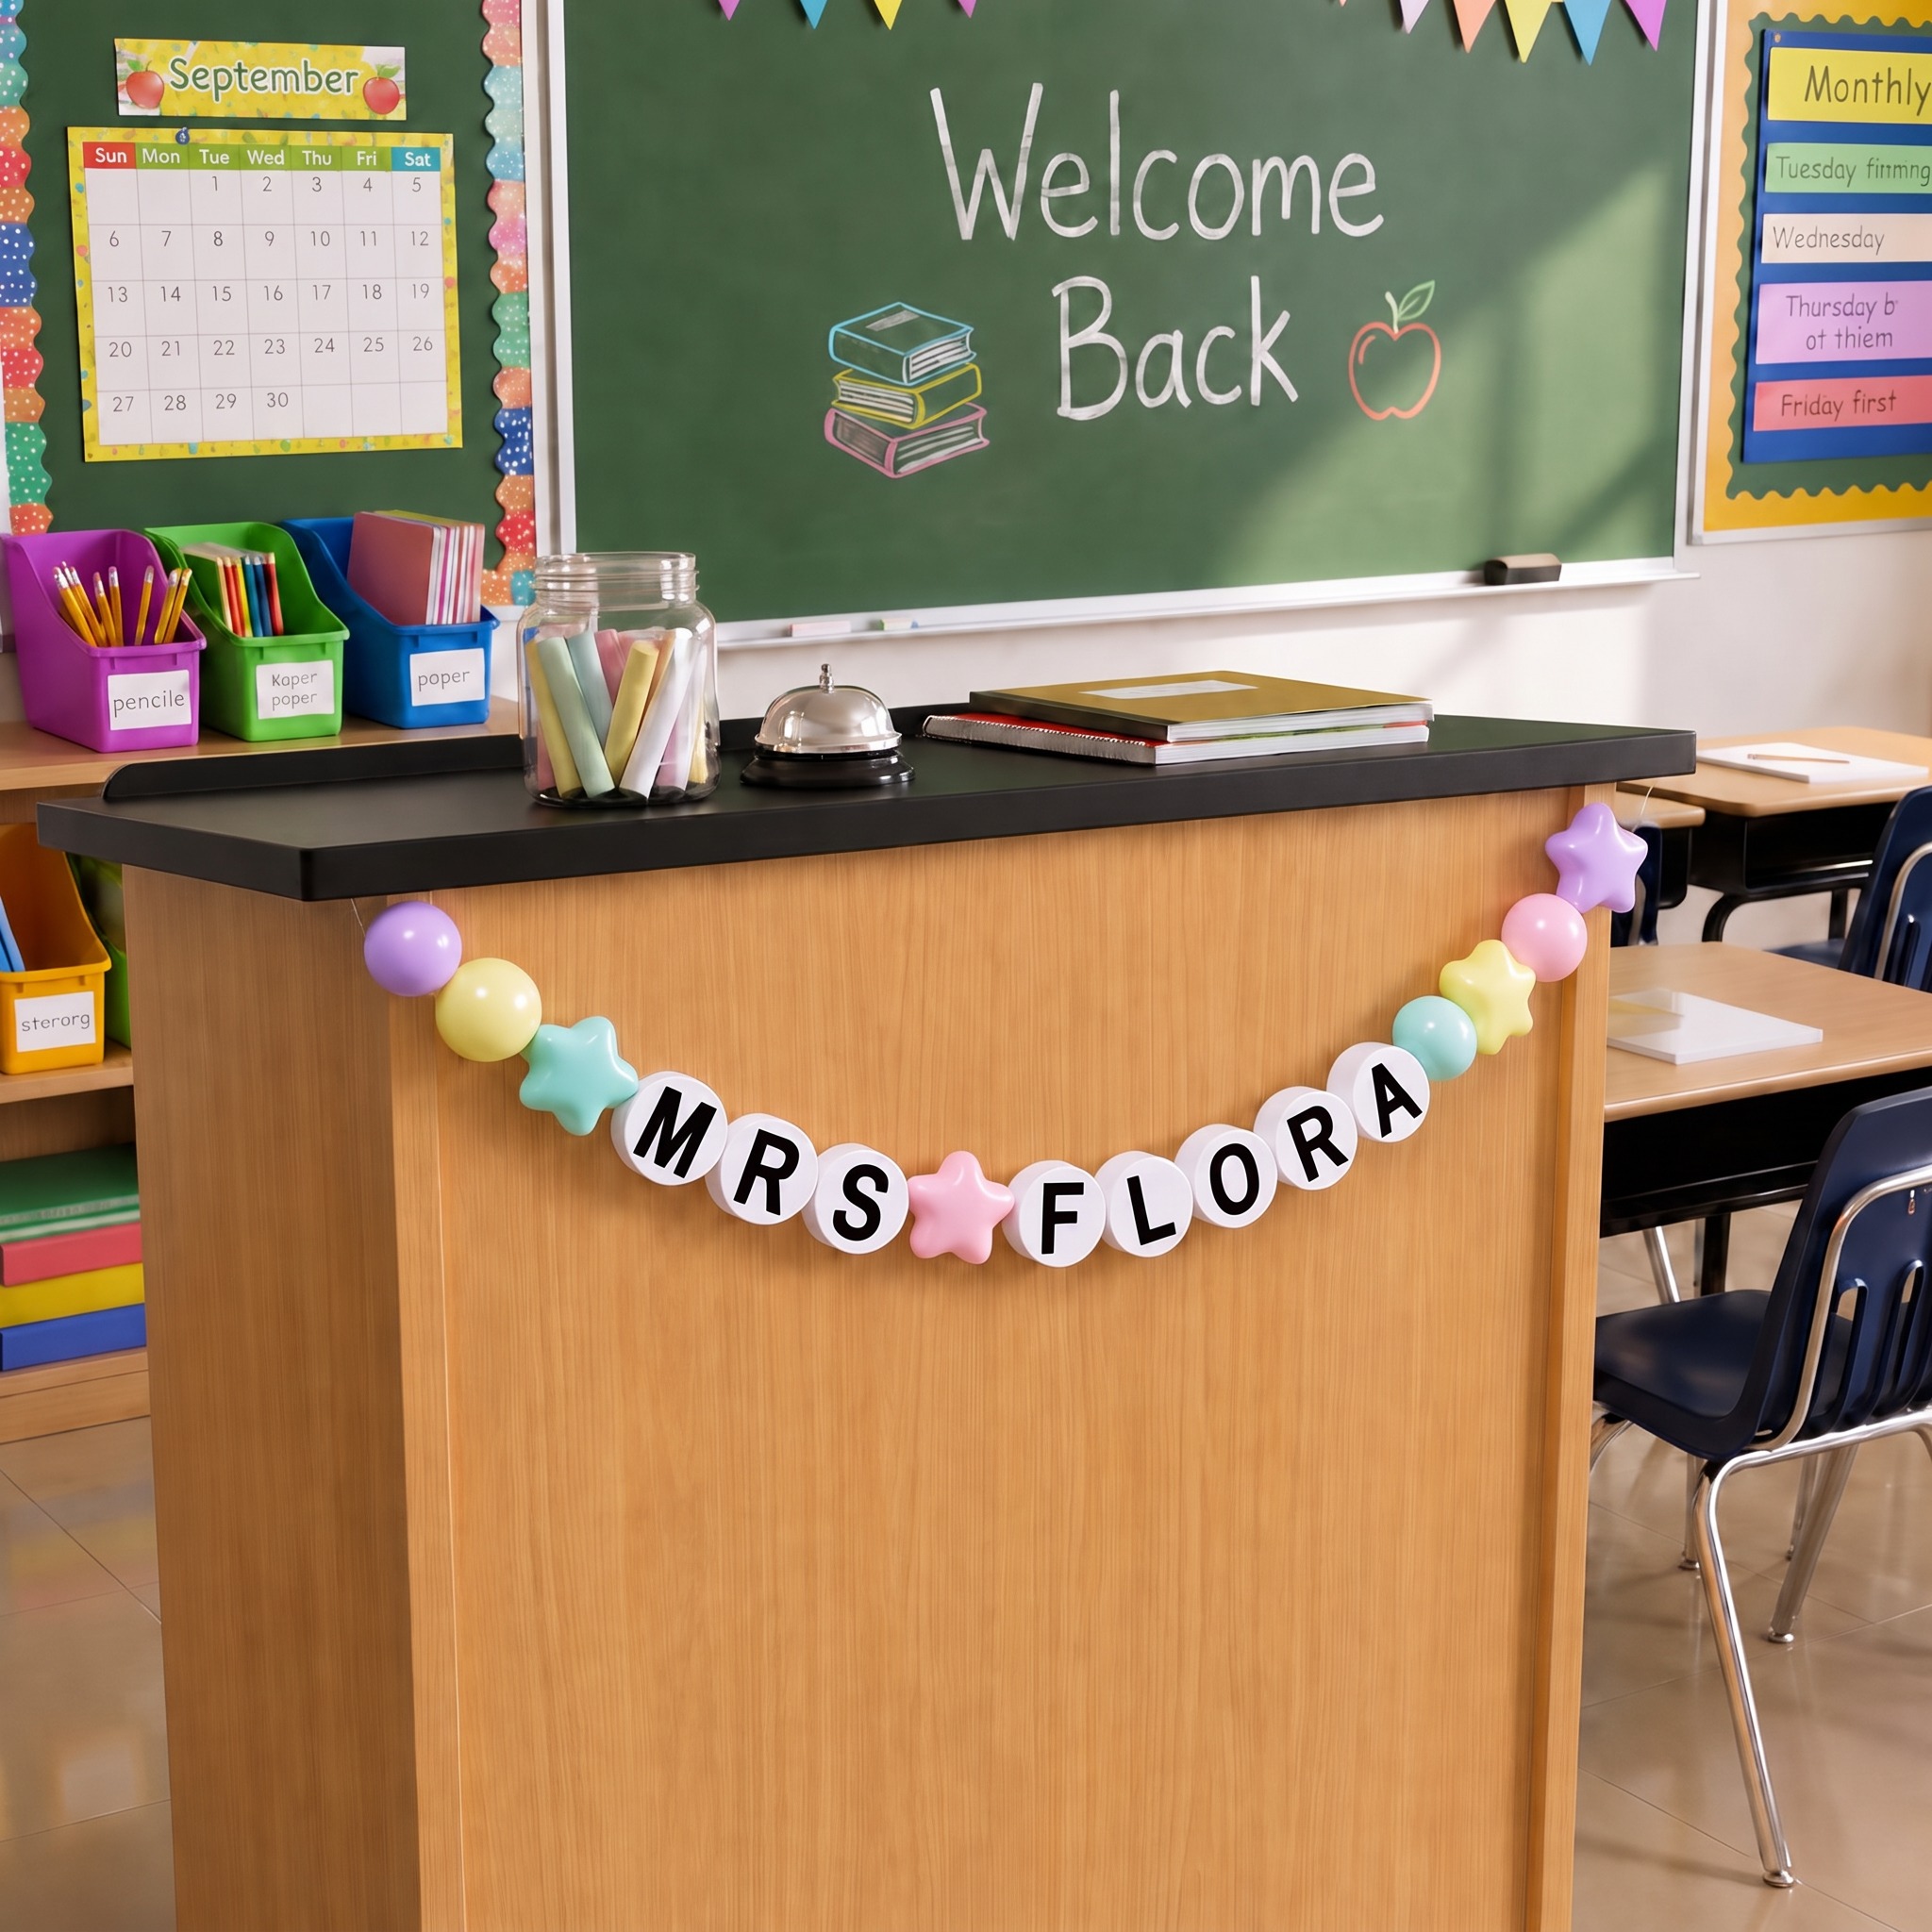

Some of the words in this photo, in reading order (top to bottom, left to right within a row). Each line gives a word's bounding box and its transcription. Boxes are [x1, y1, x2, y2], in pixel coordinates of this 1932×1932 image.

[170, 58, 358, 100] September
[1804, 65, 1932, 117] Monthly
[95, 147, 127, 163] Sun
[142, 147, 180, 164] Mon
[198, 148, 230, 165] Tue
[246, 149, 285, 166] Wed
[301, 150, 332, 166] Thu
[357, 150, 377, 166] Fri
[404, 151, 432, 167] Sat
[930, 83, 1385, 241] Welcome
[211, 175, 218, 192] 1
[262, 175, 273, 192] 2
[311, 176, 323, 192] 3
[362, 177, 373, 192] 4
[411, 176, 422, 192] 5
[1774, 156, 1857, 188] Tuesday
[109, 230, 120, 247] 6
[161, 230, 172, 247] 7
[213, 230, 224, 247] 8
[264, 230, 275, 247] 9
[310, 230, 331, 247] 10
[360, 230, 376, 247] 11
[411, 230, 429, 246] 12
[1773, 225, 1885, 256] Wednesday
[108, 286, 128, 303] 13
[160, 286, 181, 303] 14
[212, 285, 232, 302] 15
[263, 285, 284, 301] 16
[312, 284, 331, 301] 17
[362, 283, 382, 300] 18
[412, 283, 430, 299] 19
[1786, 292, 1877, 324] Thursday
[108, 341, 132, 358] 20
[161, 341, 180, 357] 21
[213, 340, 235, 356] 22
[264, 338, 286, 355] 23
[314, 337, 335, 354] 24
[363, 337, 384, 353] 25
[412, 336, 433, 352] 26
[1052, 275, 1300, 422] Back
[1835, 325, 1893, 349] thiem
[112, 395, 134, 412] 27
[164, 394, 187, 411] 28
[215, 392, 237, 409] 29
[266, 391, 289, 408] 30
[1781, 393, 1843, 422] Friday
[1853, 390, 1897, 414] first
[418, 671, 470, 691] poper
[113, 689, 185, 718] pencile
[272, 693, 318, 711] poper
[21, 1013, 91, 1032] sterorg
[632, 1086, 890, 1242] MRS
[1041, 1062, 1424, 1256] FLORA
